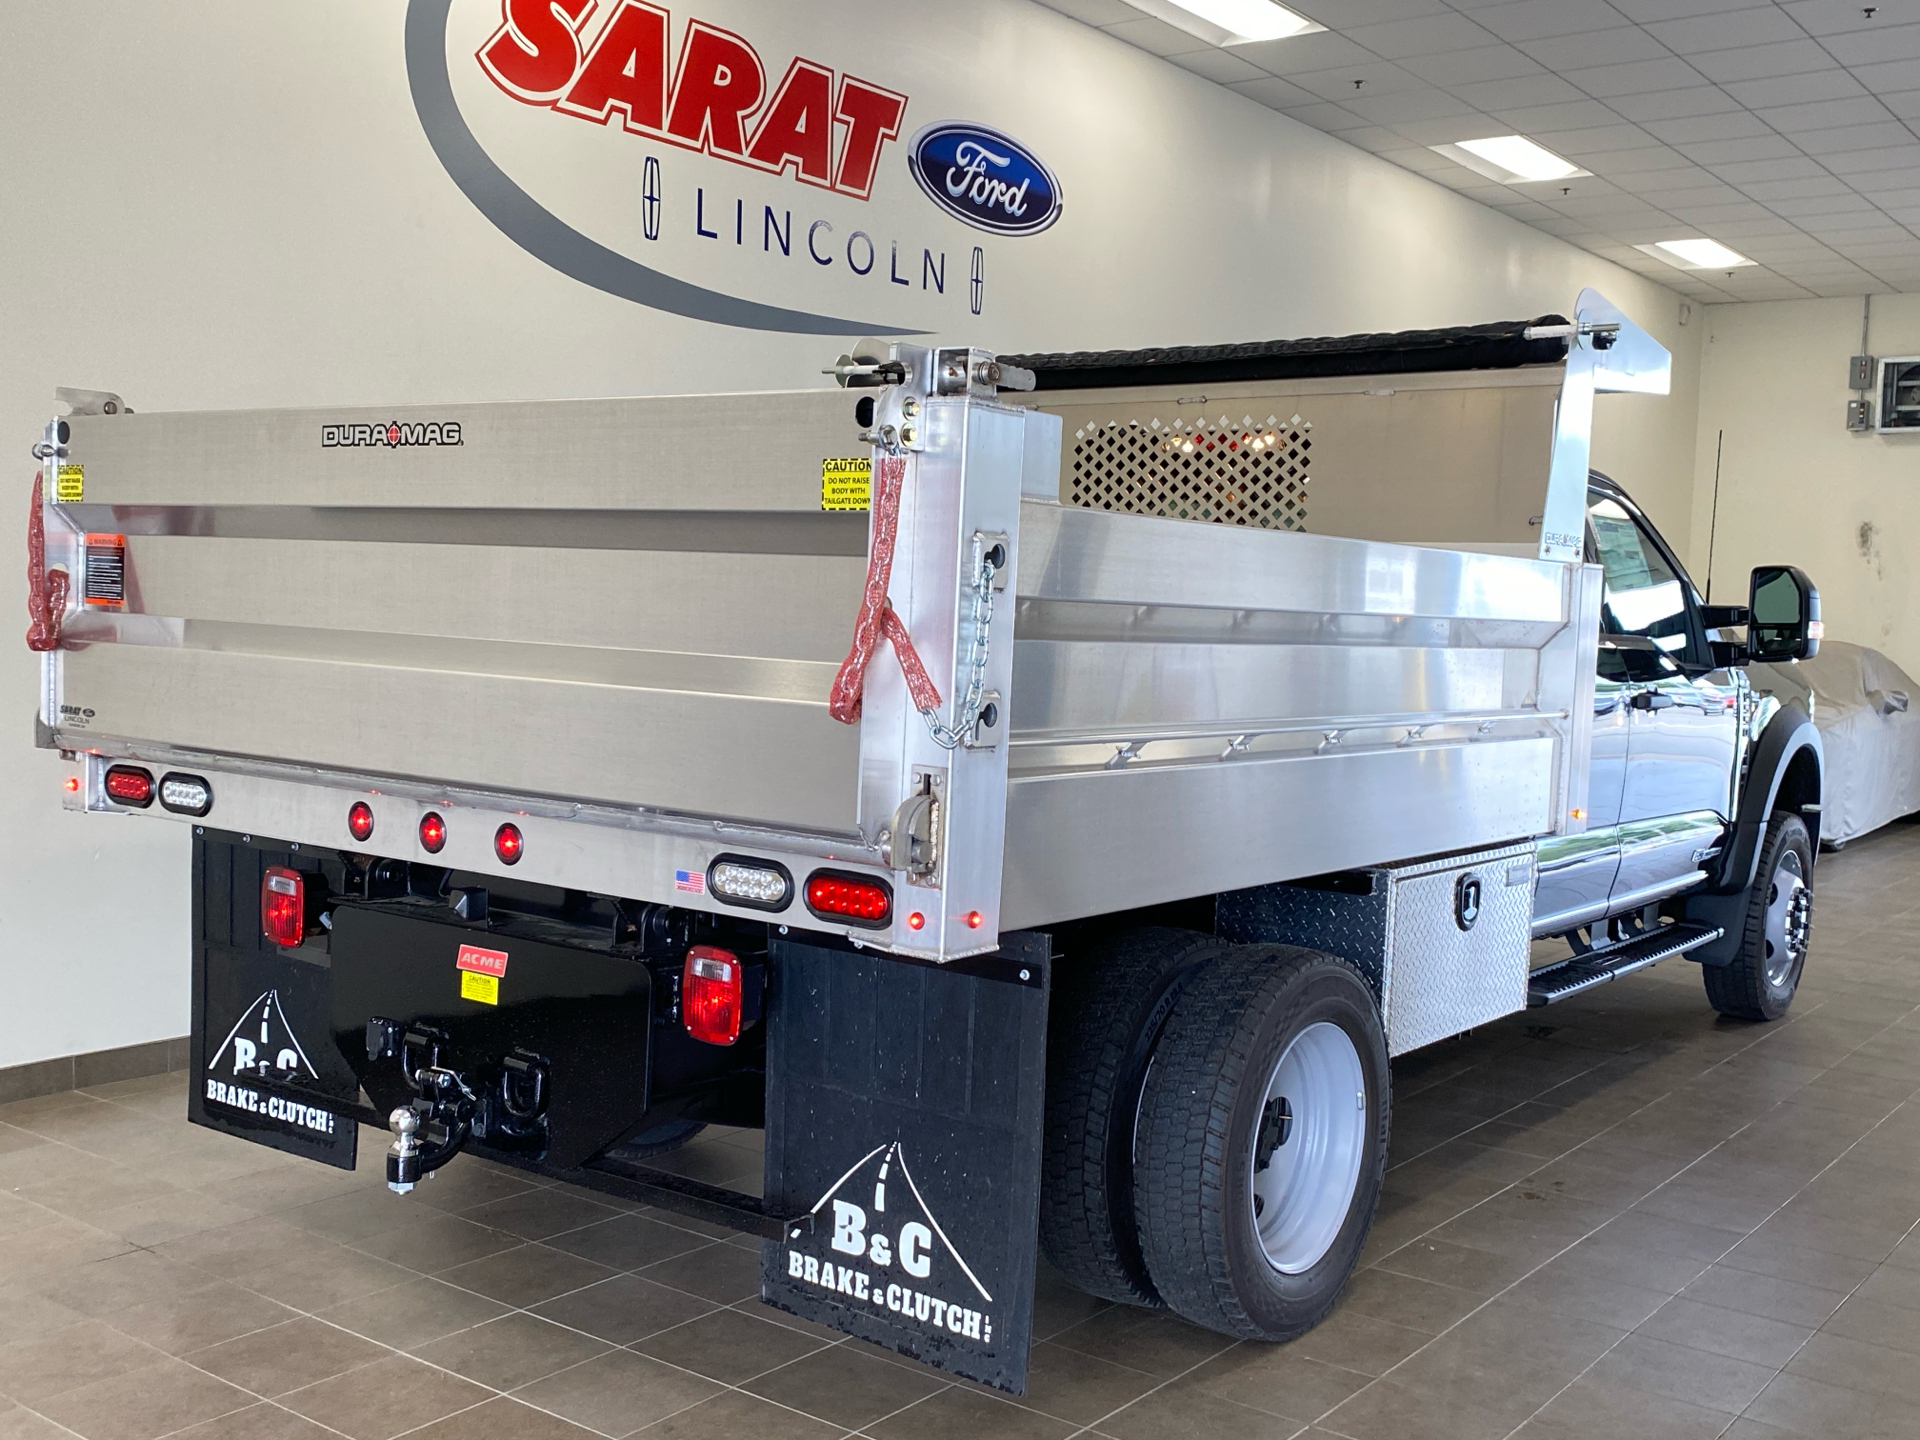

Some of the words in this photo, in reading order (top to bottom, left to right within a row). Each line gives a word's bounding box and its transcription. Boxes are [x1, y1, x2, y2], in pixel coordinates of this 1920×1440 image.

[476, 0, 908, 201] SARAT
[946, 141, 1030, 217] Ford
[697, 188, 944, 293] LINCOLN
[826, 461, 871, 471] CAUTION
[461, 952, 504, 970] ACME
[207, 1078, 259, 1113] BRAKE
[268, 1096, 328, 1132] CLUTCH
[788, 1250, 870, 1300] BRAKE
[886, 1283, 982, 1340] CLUTCH
